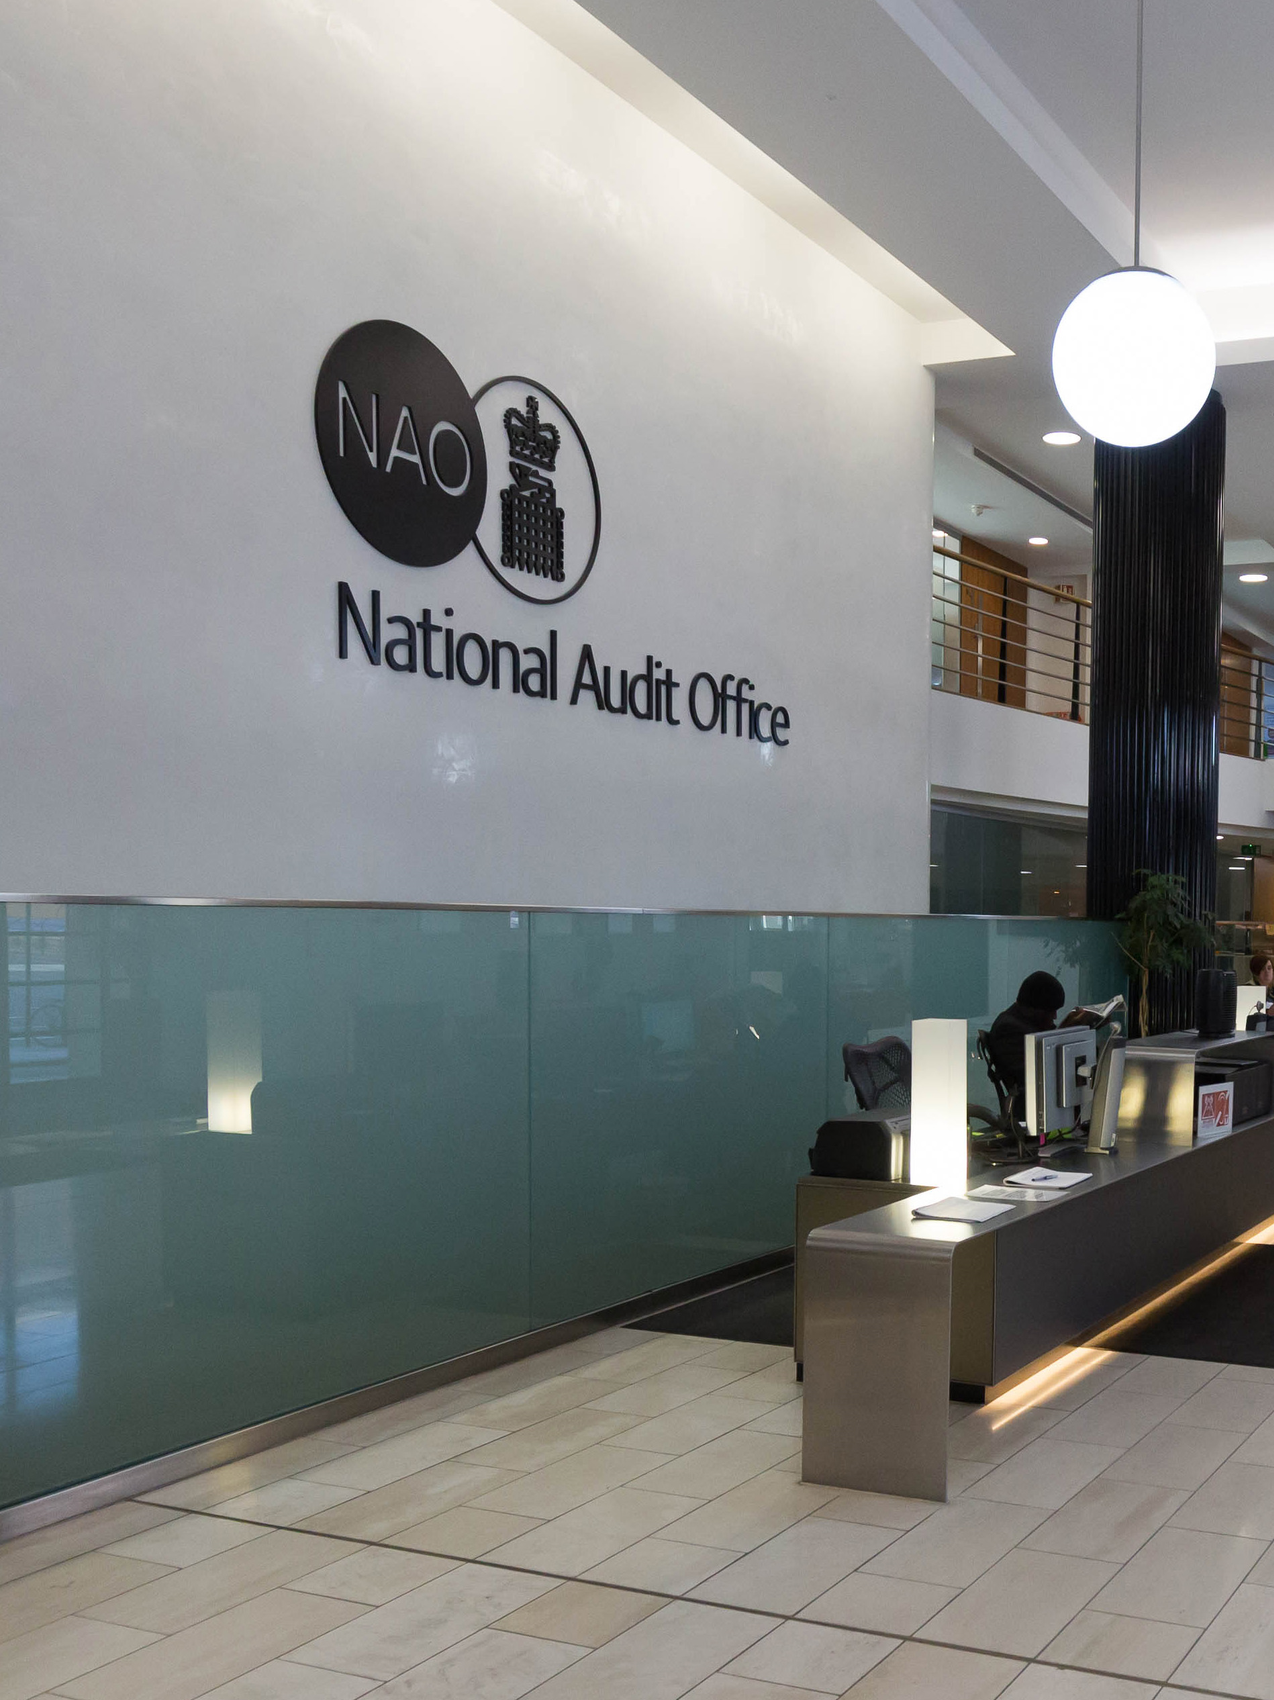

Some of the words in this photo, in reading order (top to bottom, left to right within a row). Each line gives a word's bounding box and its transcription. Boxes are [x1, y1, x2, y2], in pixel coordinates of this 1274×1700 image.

[338, 381, 471, 497] NAO
[337, 580, 558, 701] National
[569, 643, 681, 726] Audit
[688, 671, 791, 747] Office
